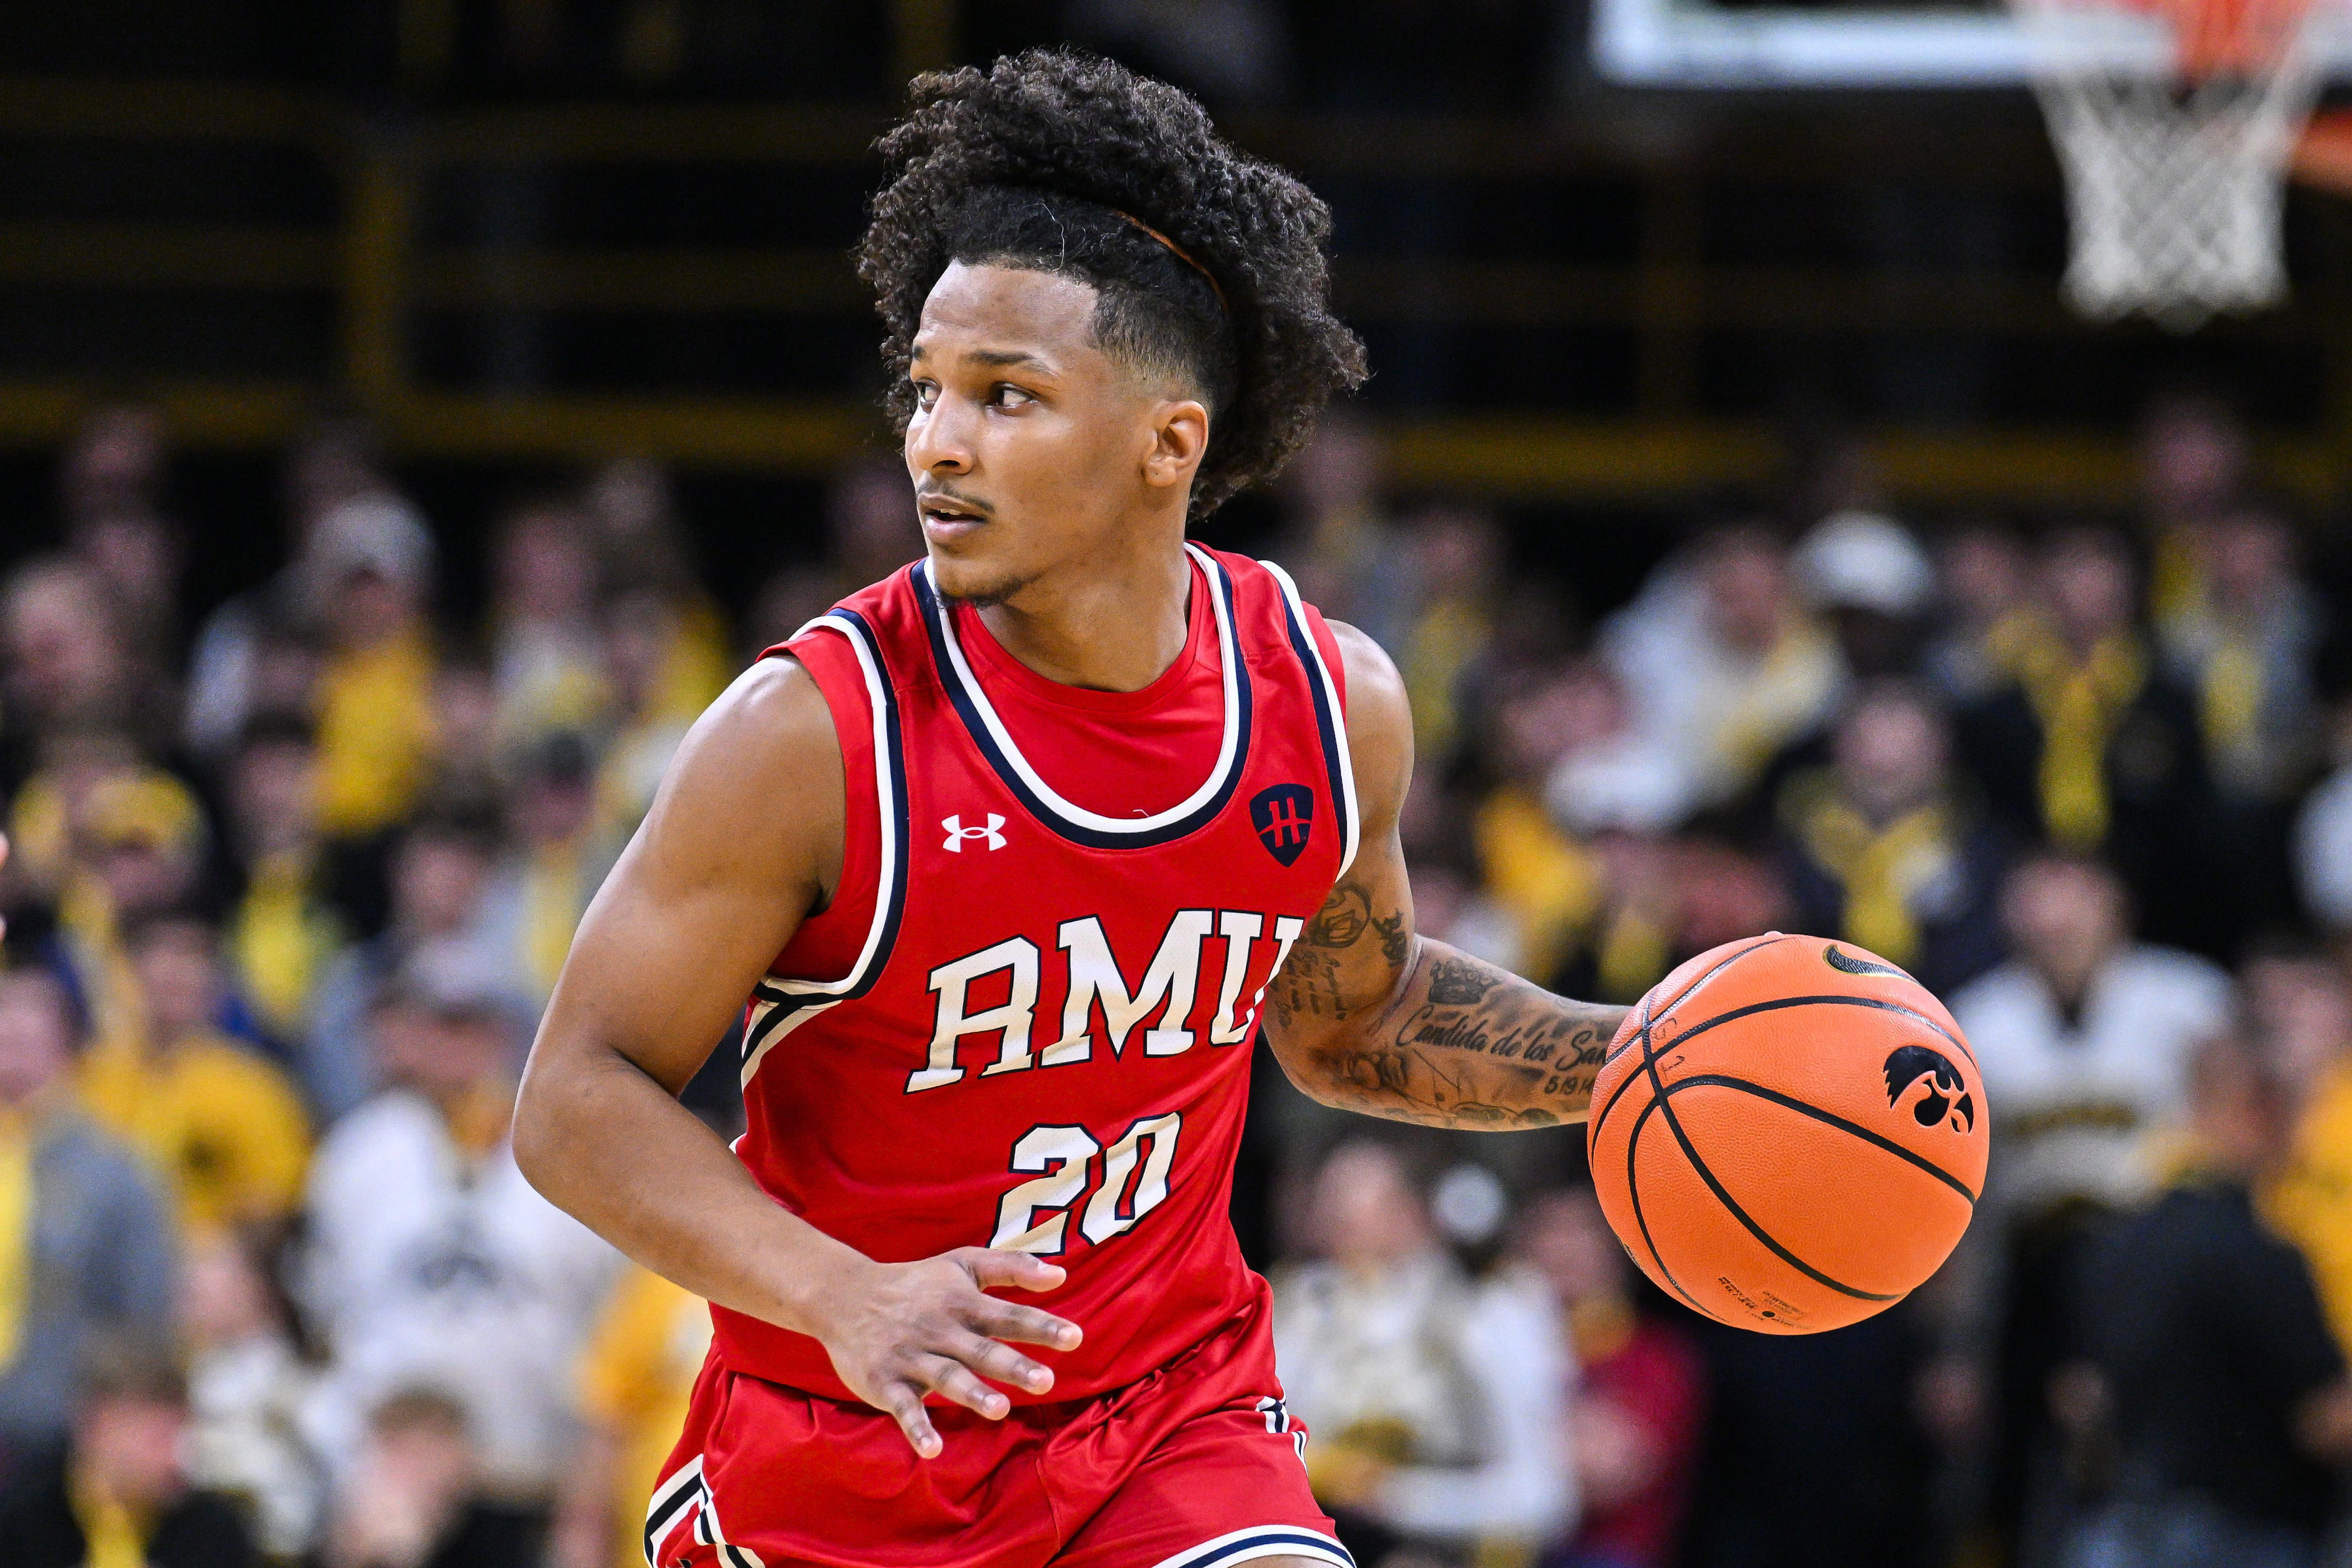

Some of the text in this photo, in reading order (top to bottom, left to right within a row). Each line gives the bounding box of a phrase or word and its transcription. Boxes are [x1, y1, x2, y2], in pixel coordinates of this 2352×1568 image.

[903, 908, 1305, 1095] RMU
[1395, 1004, 1488, 1053] Candida
[1490, 1027, 1522, 1057] de
[1523, 1031, 1555, 1061] los
[988, 1111, 1184, 1256] 20
